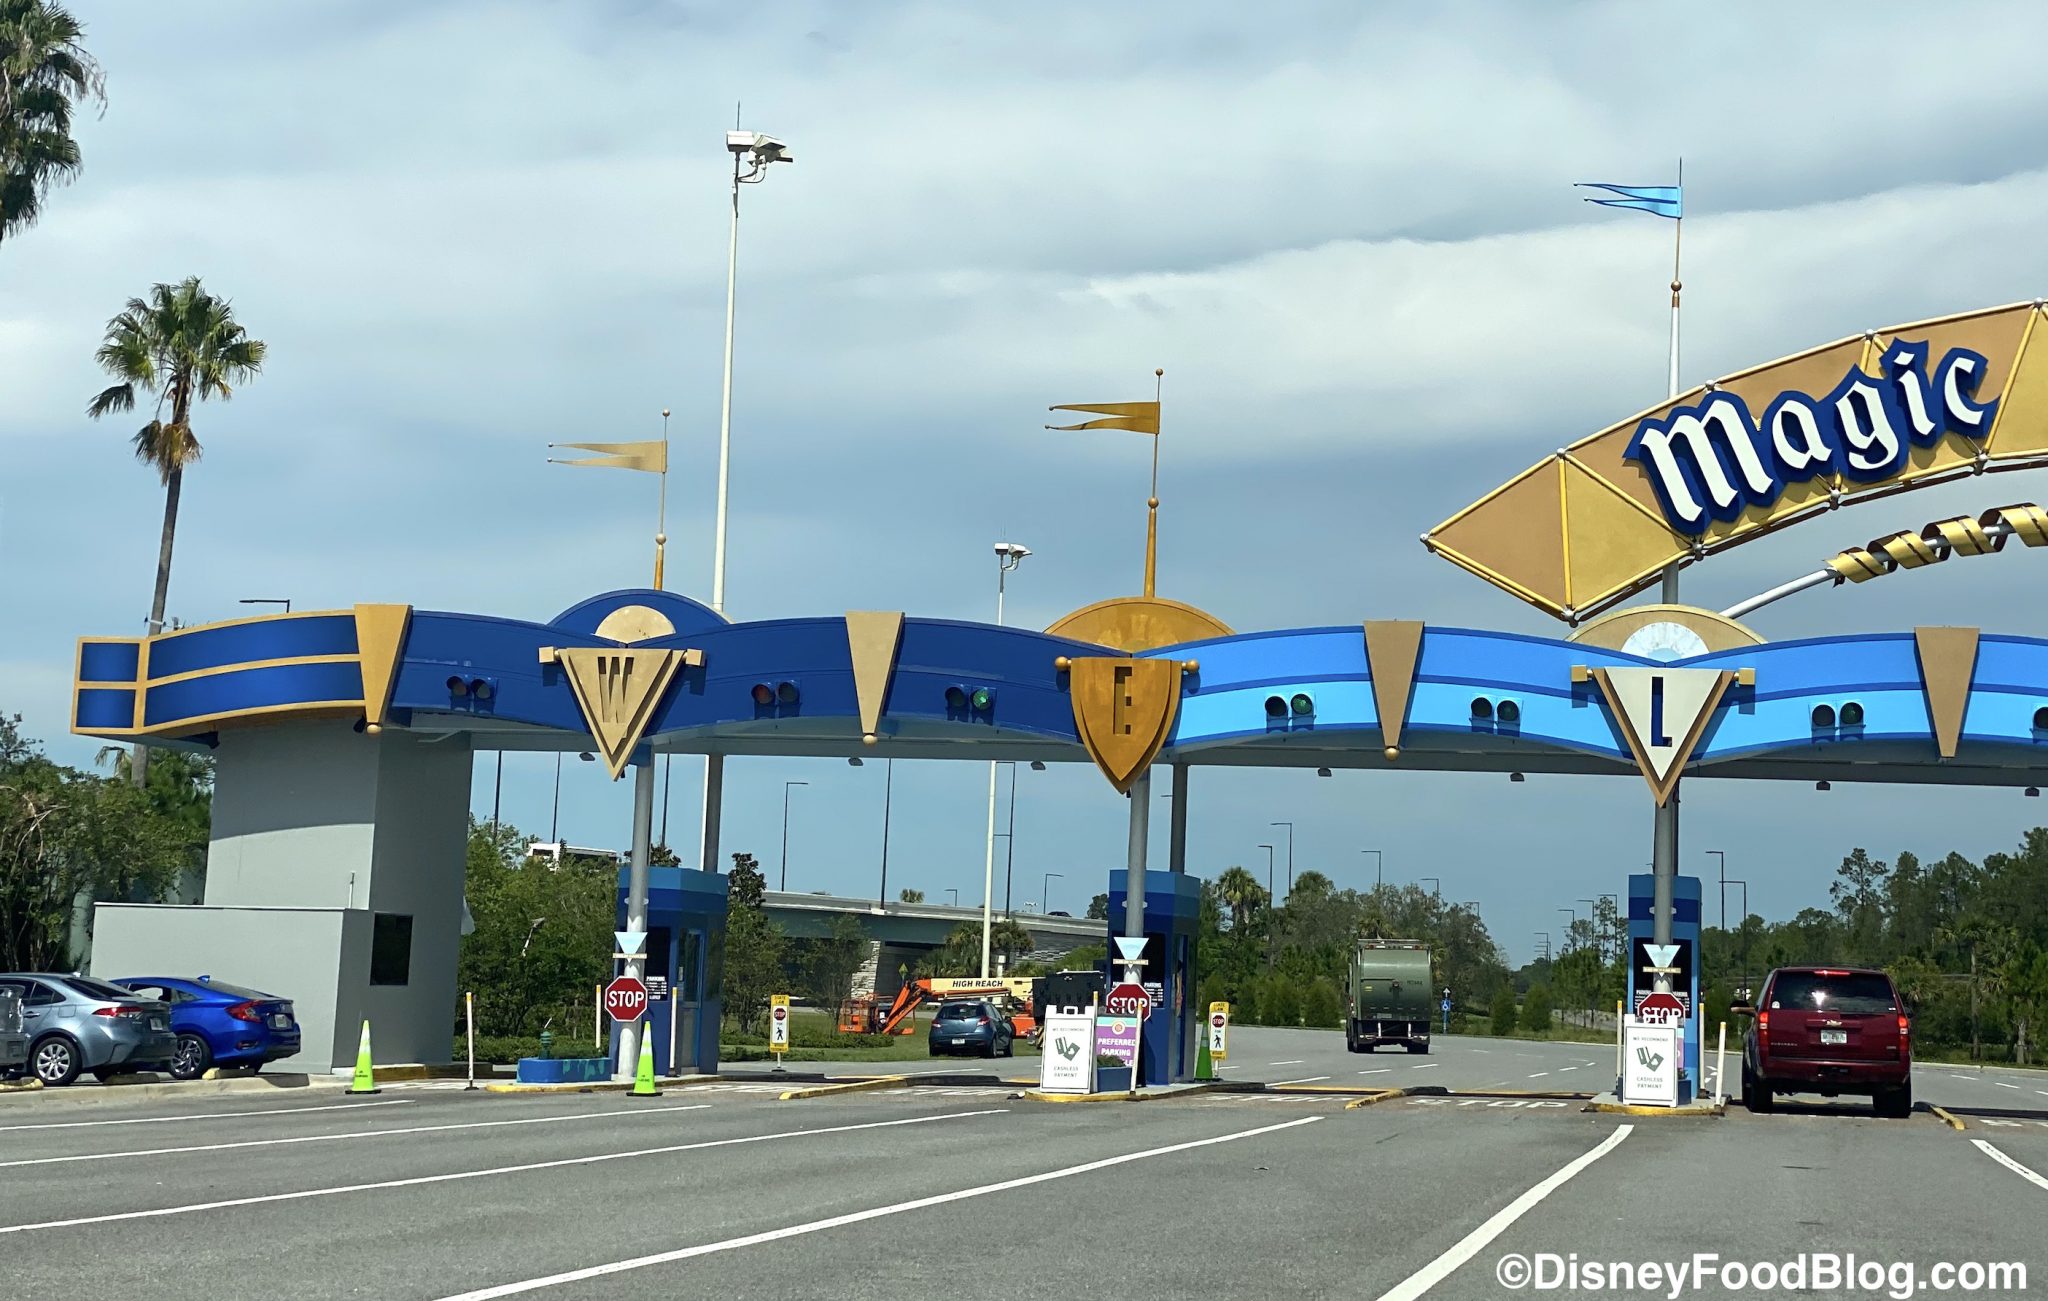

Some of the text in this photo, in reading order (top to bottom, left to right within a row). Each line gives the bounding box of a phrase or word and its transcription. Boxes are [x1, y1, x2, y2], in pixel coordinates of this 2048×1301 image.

[1640, 350, 1985, 523] Magic
[597, 656, 635, 723] W
[1113, 666, 1132, 735] E
[1651, 676, 1673, 748] L
[952, 980, 973, 988] HIGH
[607, 990, 645, 1008] STOP
[1110, 997, 1148, 1014] STOP
[1097, 1038, 1136, 1046] PREFERRED
[1101, 1048, 1131, 1056] PARKING
[1406, 1099, 1569, 1109] STOP
